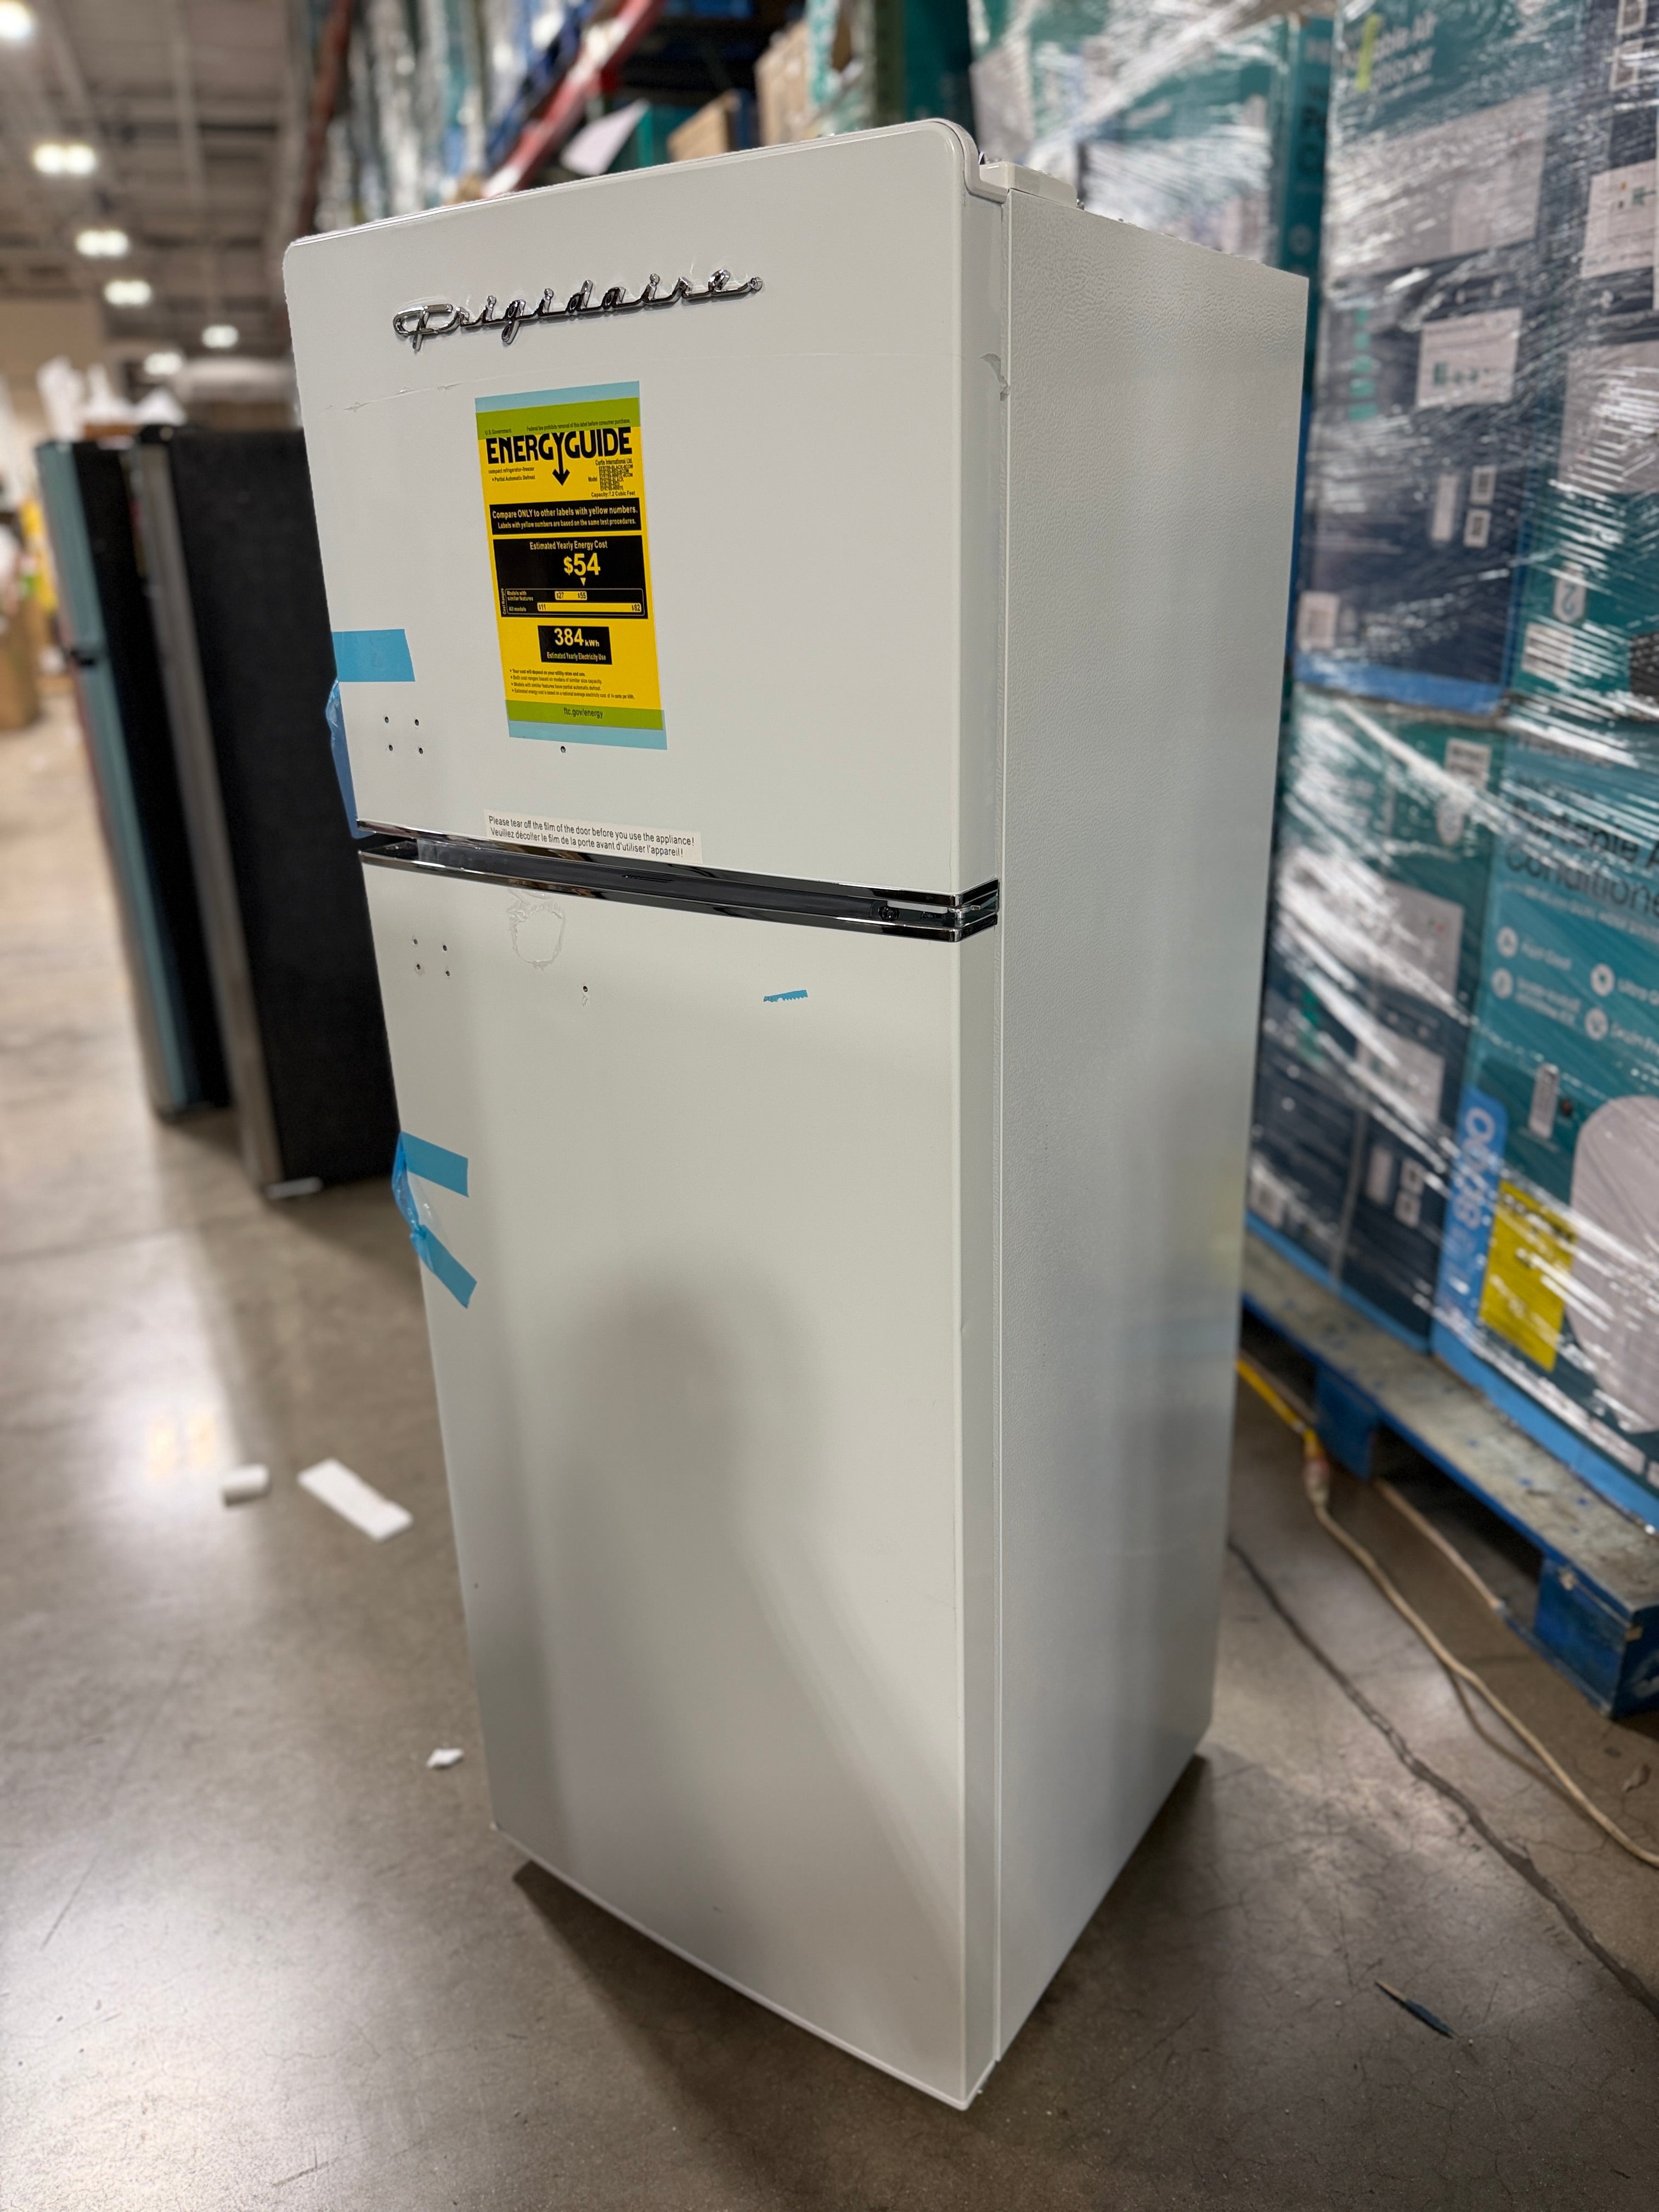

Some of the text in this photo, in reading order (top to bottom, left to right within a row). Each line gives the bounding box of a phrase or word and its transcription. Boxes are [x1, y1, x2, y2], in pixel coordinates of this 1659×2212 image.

[393, 269, 764, 352] Frigidaire
[486, 426, 632, 464] ENERGYGUIDE
[492, 510, 517, 520] Compare
[517, 509, 533, 518] ONLY
[540, 508, 555, 517] other
[556, 507, 574, 516] labels
[575, 506, 588, 516] with
[589, 506, 609, 517] yellow
[609, 505, 638, 515] numbers.
[521, 521, 534, 529] yellow
[609, 517, 636, 527] procedures.
[529, 540, 608, 551] Estimated Yearly Energy Cost
[563, 552, 601, 576] $54
[554, 628, 600, 647] 384 kWh
[546, 651, 566, 659] Estimated
[566, 652, 578, 662] Yearly
[564, 707, 603, 719] ftc.gov/energy
[488, 815, 695, 847] Please tear off the film of the door before you use the appliance!
[490, 826, 684, 857] Veuillez décoller le film de la porte avant d'utiliser l'appareil!
